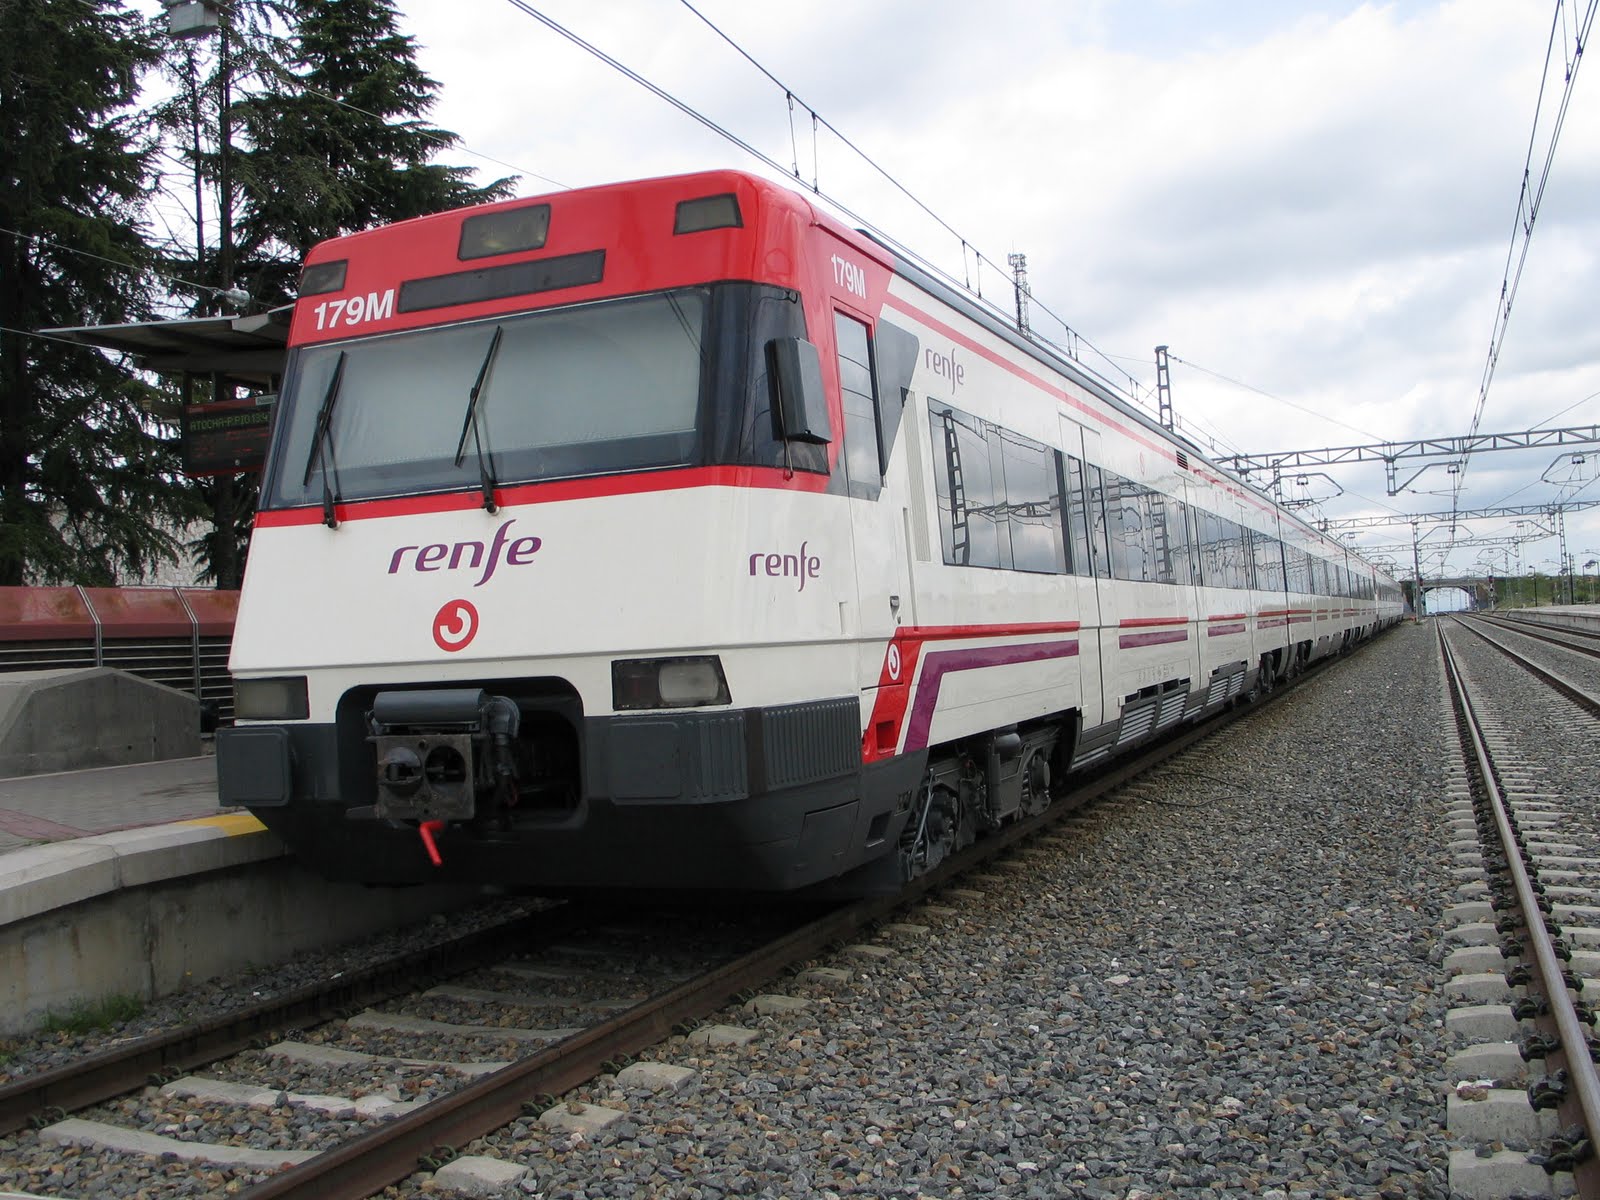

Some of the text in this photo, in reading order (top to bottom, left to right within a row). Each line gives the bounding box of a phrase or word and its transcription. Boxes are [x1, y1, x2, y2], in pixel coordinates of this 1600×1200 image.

[831, 253, 867, 300] 179M
[314, 289, 395, 331] 179M
[925, 348, 965, 395] renfe
[388, 519, 542, 587] renfe
[749, 541, 820, 592] renfe
